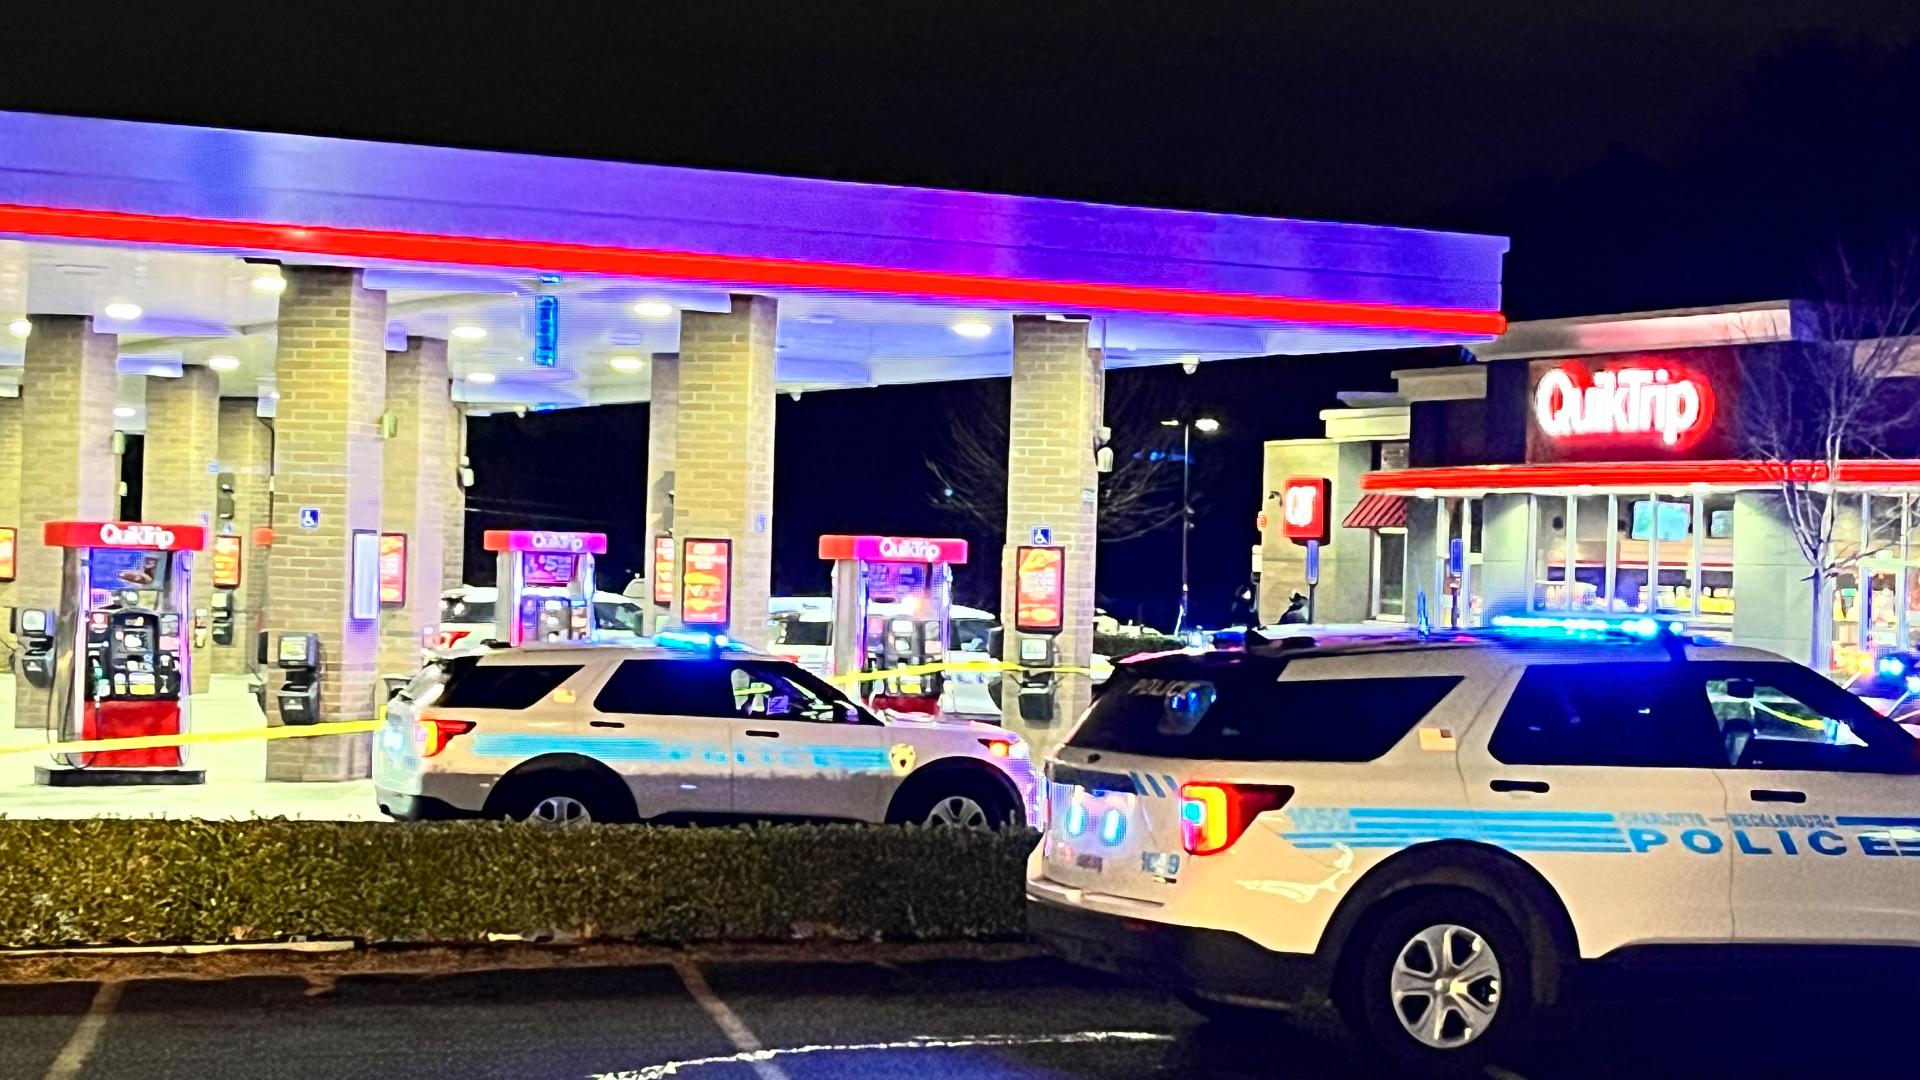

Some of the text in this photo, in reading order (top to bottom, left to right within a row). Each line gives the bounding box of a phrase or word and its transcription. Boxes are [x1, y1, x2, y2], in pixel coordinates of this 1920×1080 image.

[1535, 368, 1699, 445] QuikTrip
[1285, 486, 1317, 527] QT
[100, 523, 174, 549] QuikTrip
[880, 538, 941, 562] QuikTrip
[1627, 827, 1900, 857] POLICE
